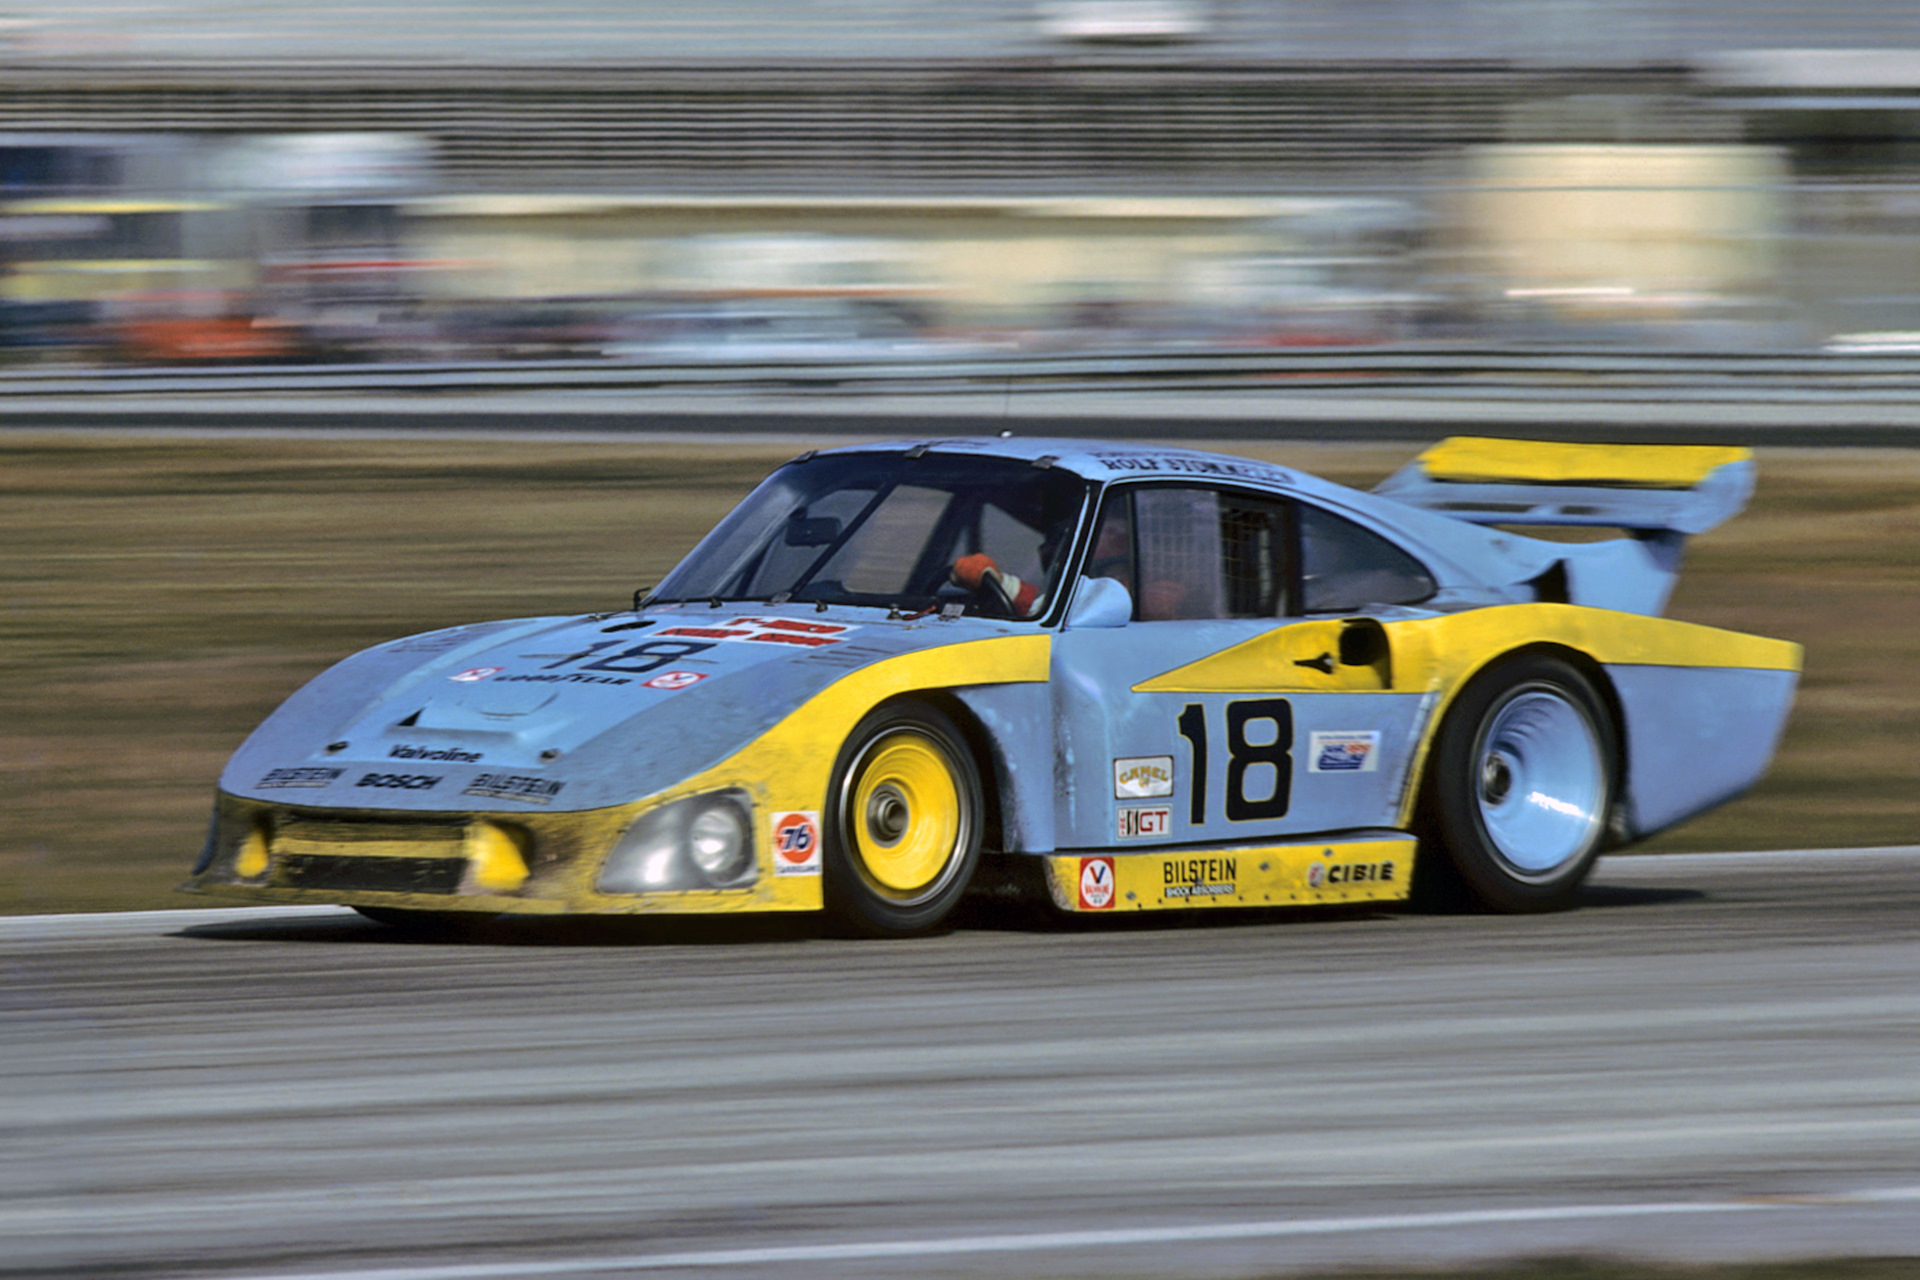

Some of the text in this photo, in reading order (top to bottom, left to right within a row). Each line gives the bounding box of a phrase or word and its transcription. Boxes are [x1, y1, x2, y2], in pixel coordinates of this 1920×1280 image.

[1177, 697, 1293, 826] 18
[355, 773, 445, 790] BOSCH
[464, 773, 567, 796] BILSTEIN
[1119, 765, 1169, 785] CAMEL
[1140, 811, 1168, 833] GT
[780, 823, 812, 851] 76
[1164, 857, 1237, 885] BILSTEIN
